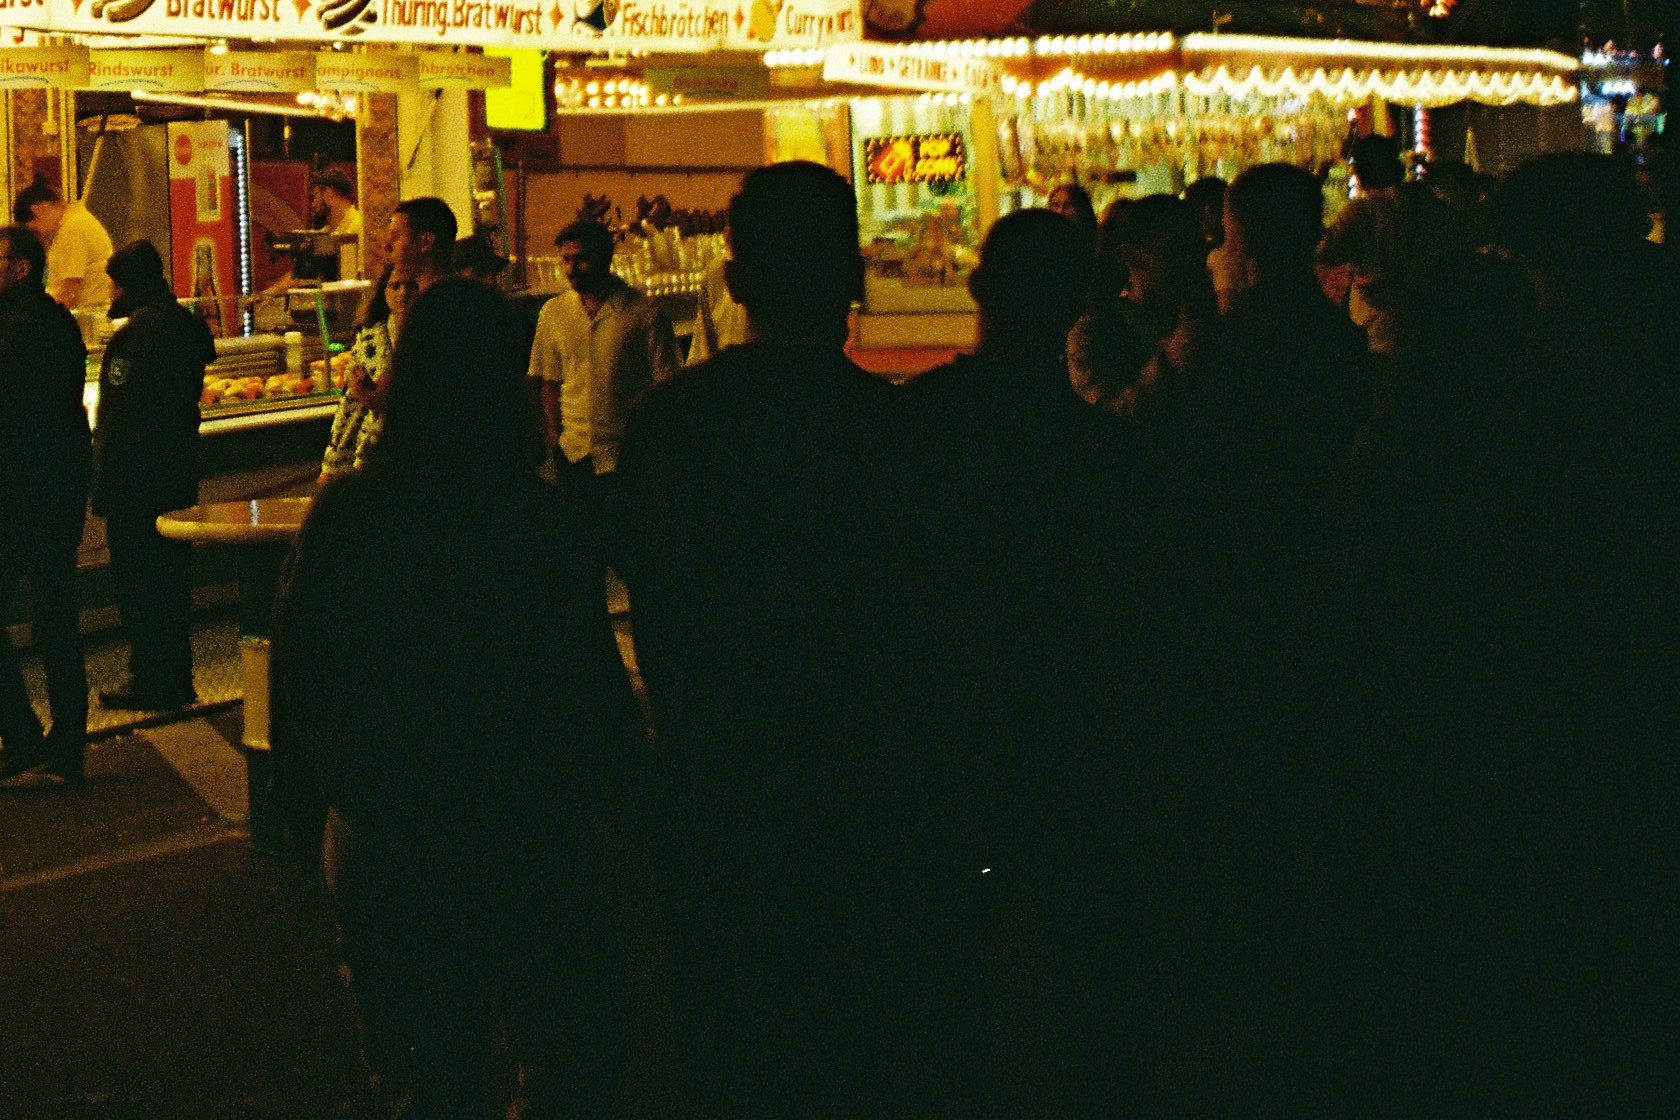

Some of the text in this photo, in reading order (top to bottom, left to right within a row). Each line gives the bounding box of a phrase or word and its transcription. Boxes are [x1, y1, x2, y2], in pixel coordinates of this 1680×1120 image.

[621, 1, 729, 40] Fischbrötchen
[89, 61, 174, 79] Rindswurst
[231, 62, 306, 79] Bratwurst
